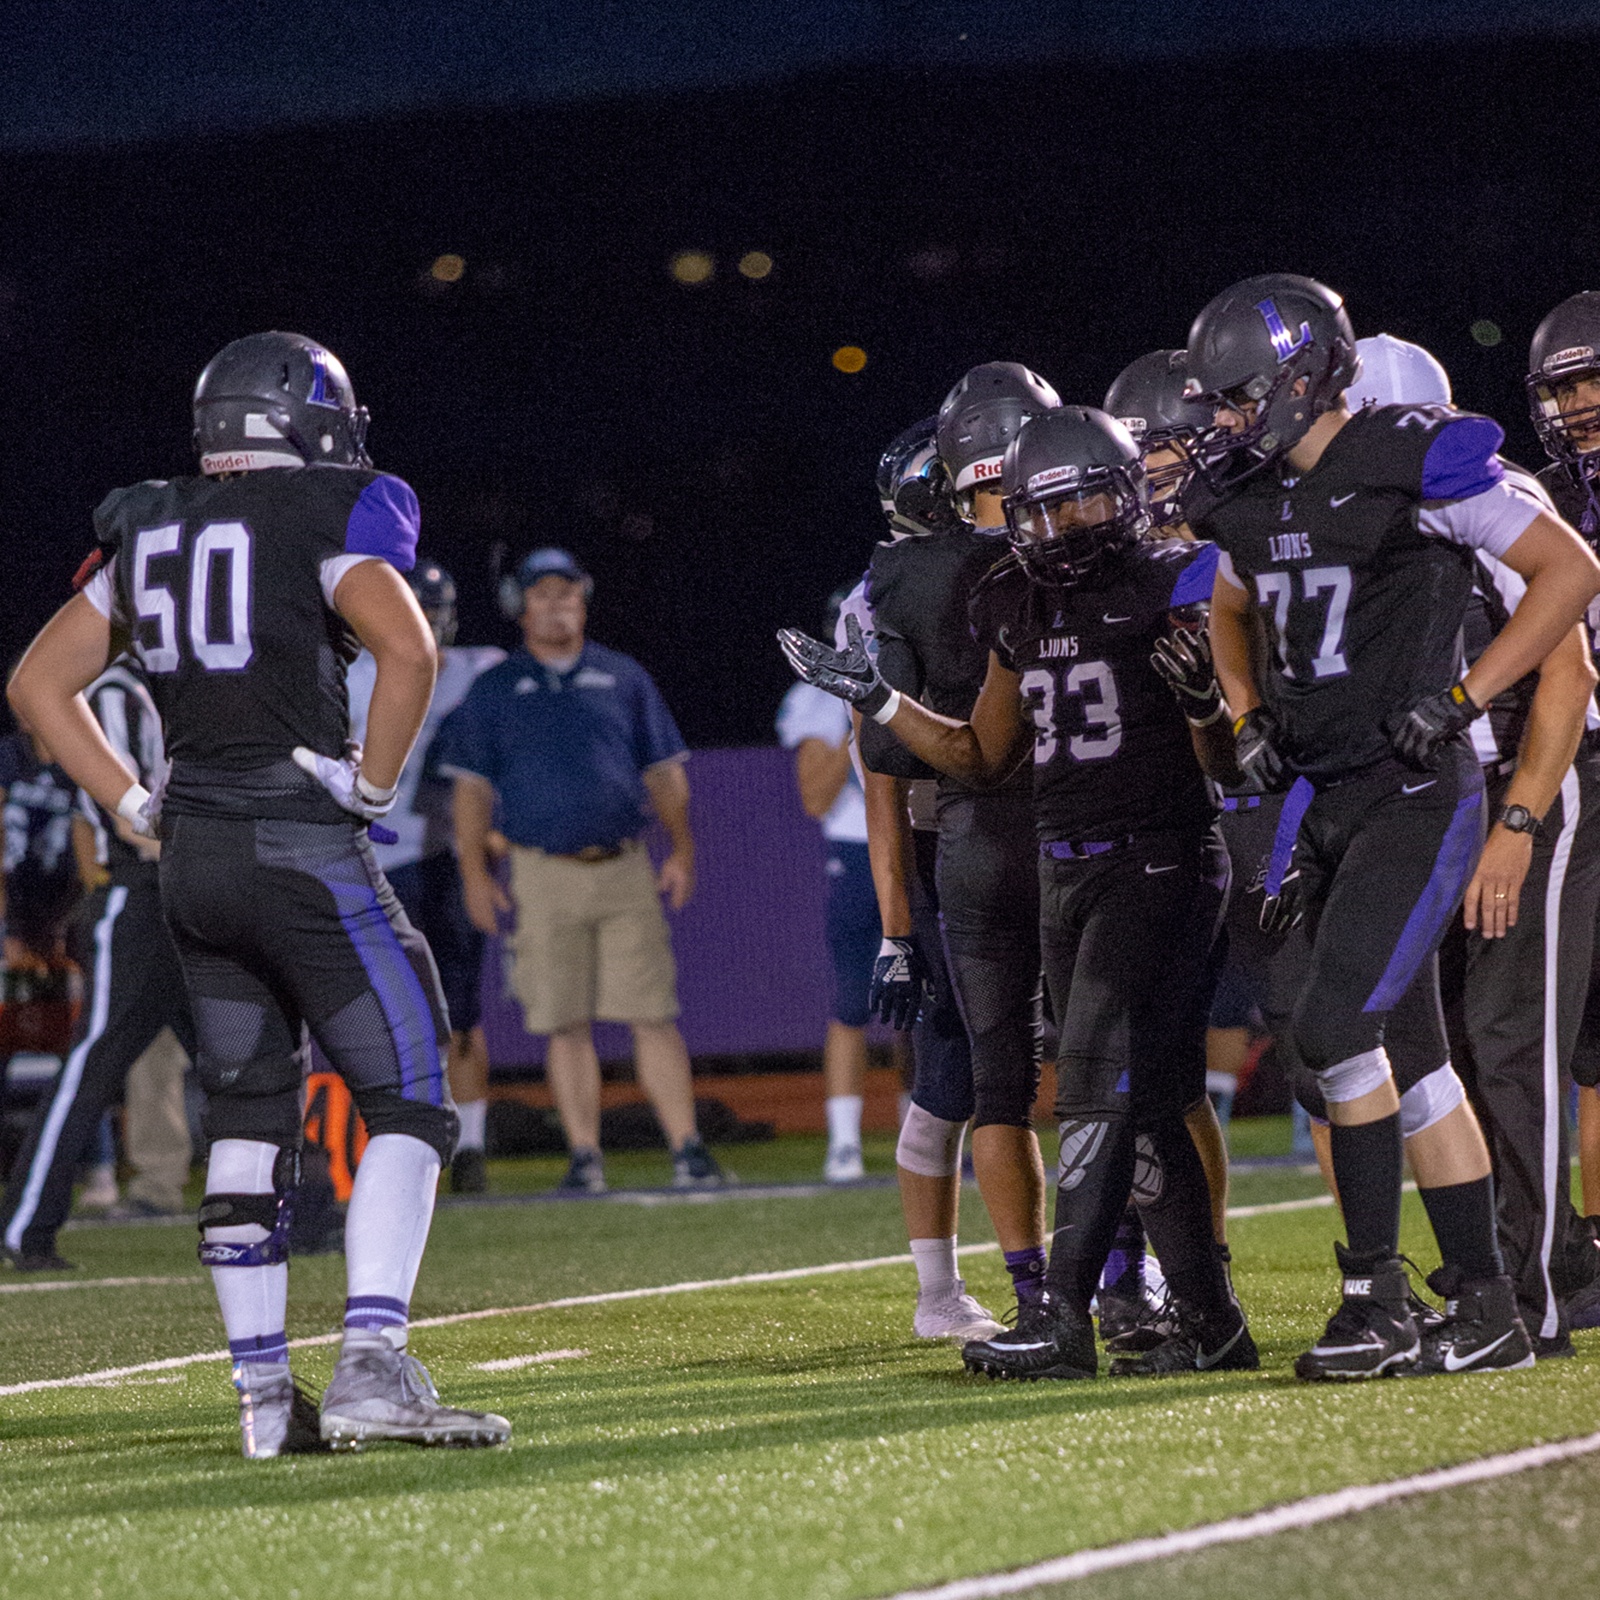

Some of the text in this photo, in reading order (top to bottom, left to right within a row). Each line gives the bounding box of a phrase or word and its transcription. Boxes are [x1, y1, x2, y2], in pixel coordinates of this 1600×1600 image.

[1039, 468, 1068, 481] Riddell
[1268, 532, 1312, 562] LIONS
[133, 521, 254, 672] 50
[1255, 565, 1352, 680] 77
[1038, 635, 1079, 658] LIONS
[1019, 660, 1123, 765] 33
